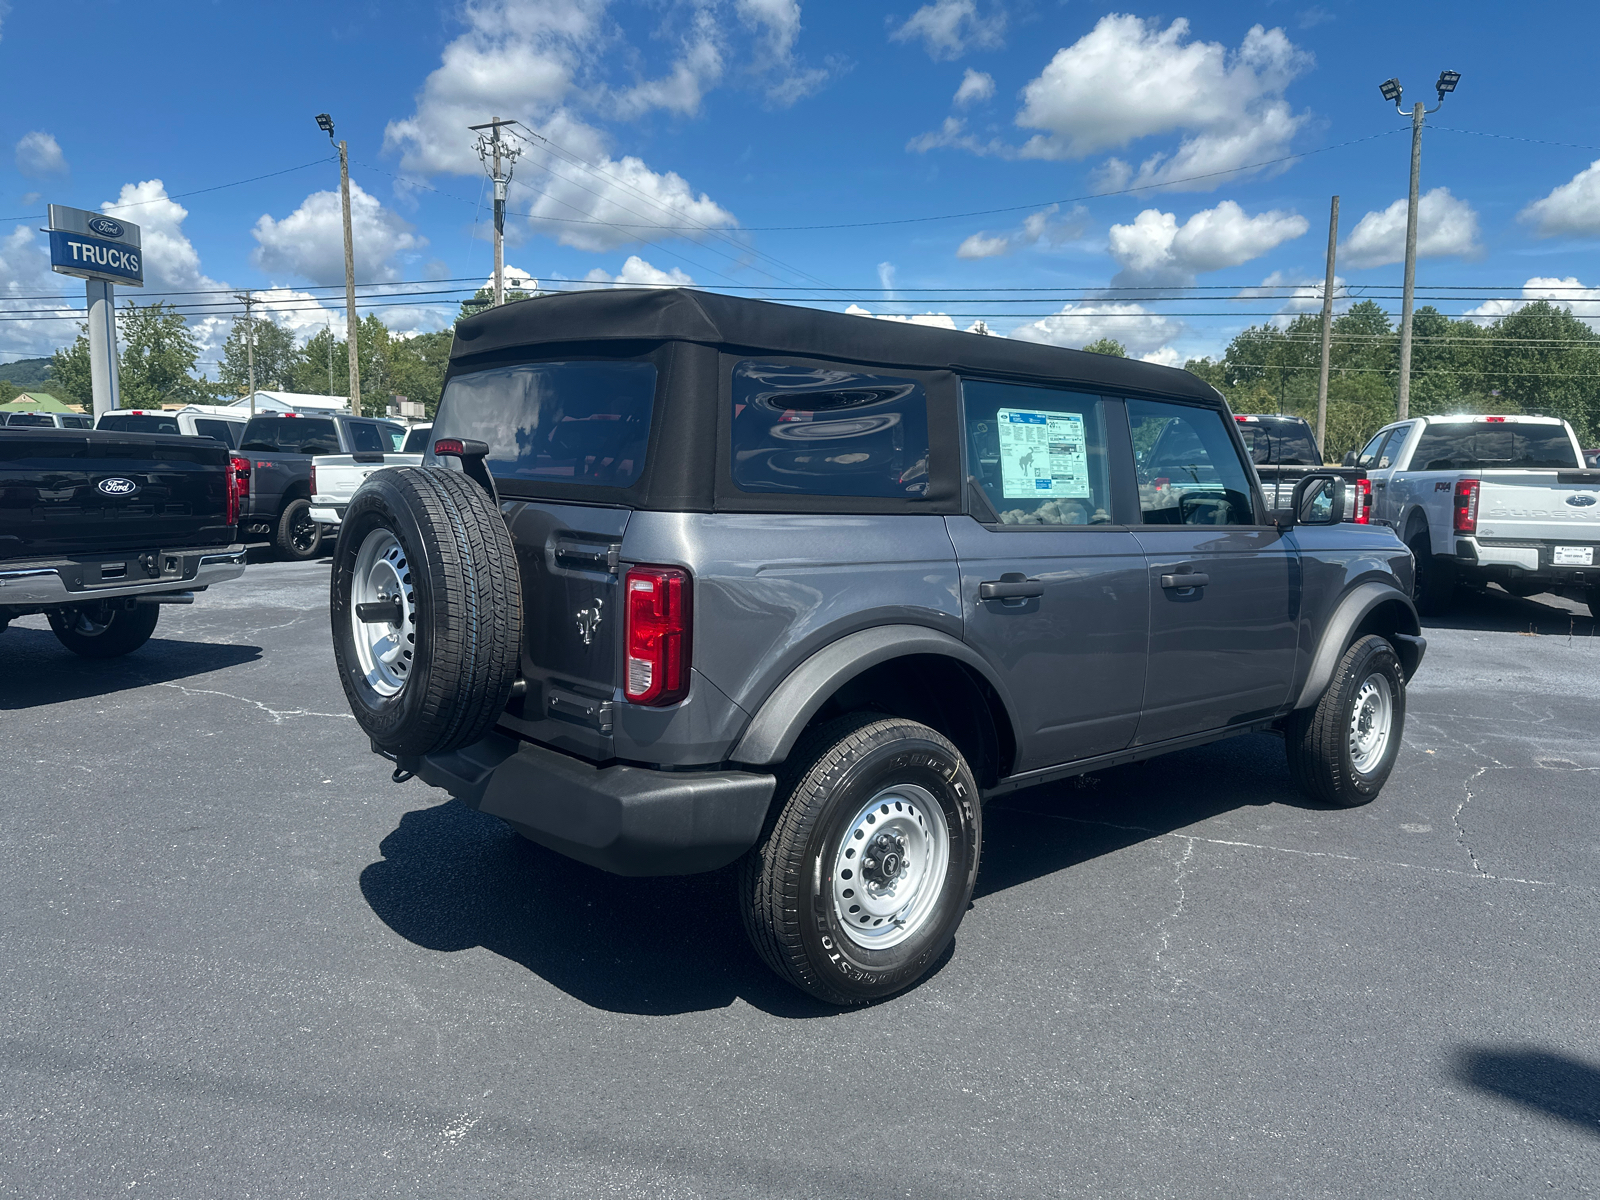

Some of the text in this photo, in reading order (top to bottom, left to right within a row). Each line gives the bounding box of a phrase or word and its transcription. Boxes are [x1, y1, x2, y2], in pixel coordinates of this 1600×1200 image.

[98, 220, 119, 235] Ford
[67, 241, 139, 272] TRUCKS
[105, 480, 130, 492] Ford
[1489, 508, 1588, 519] SUPER
